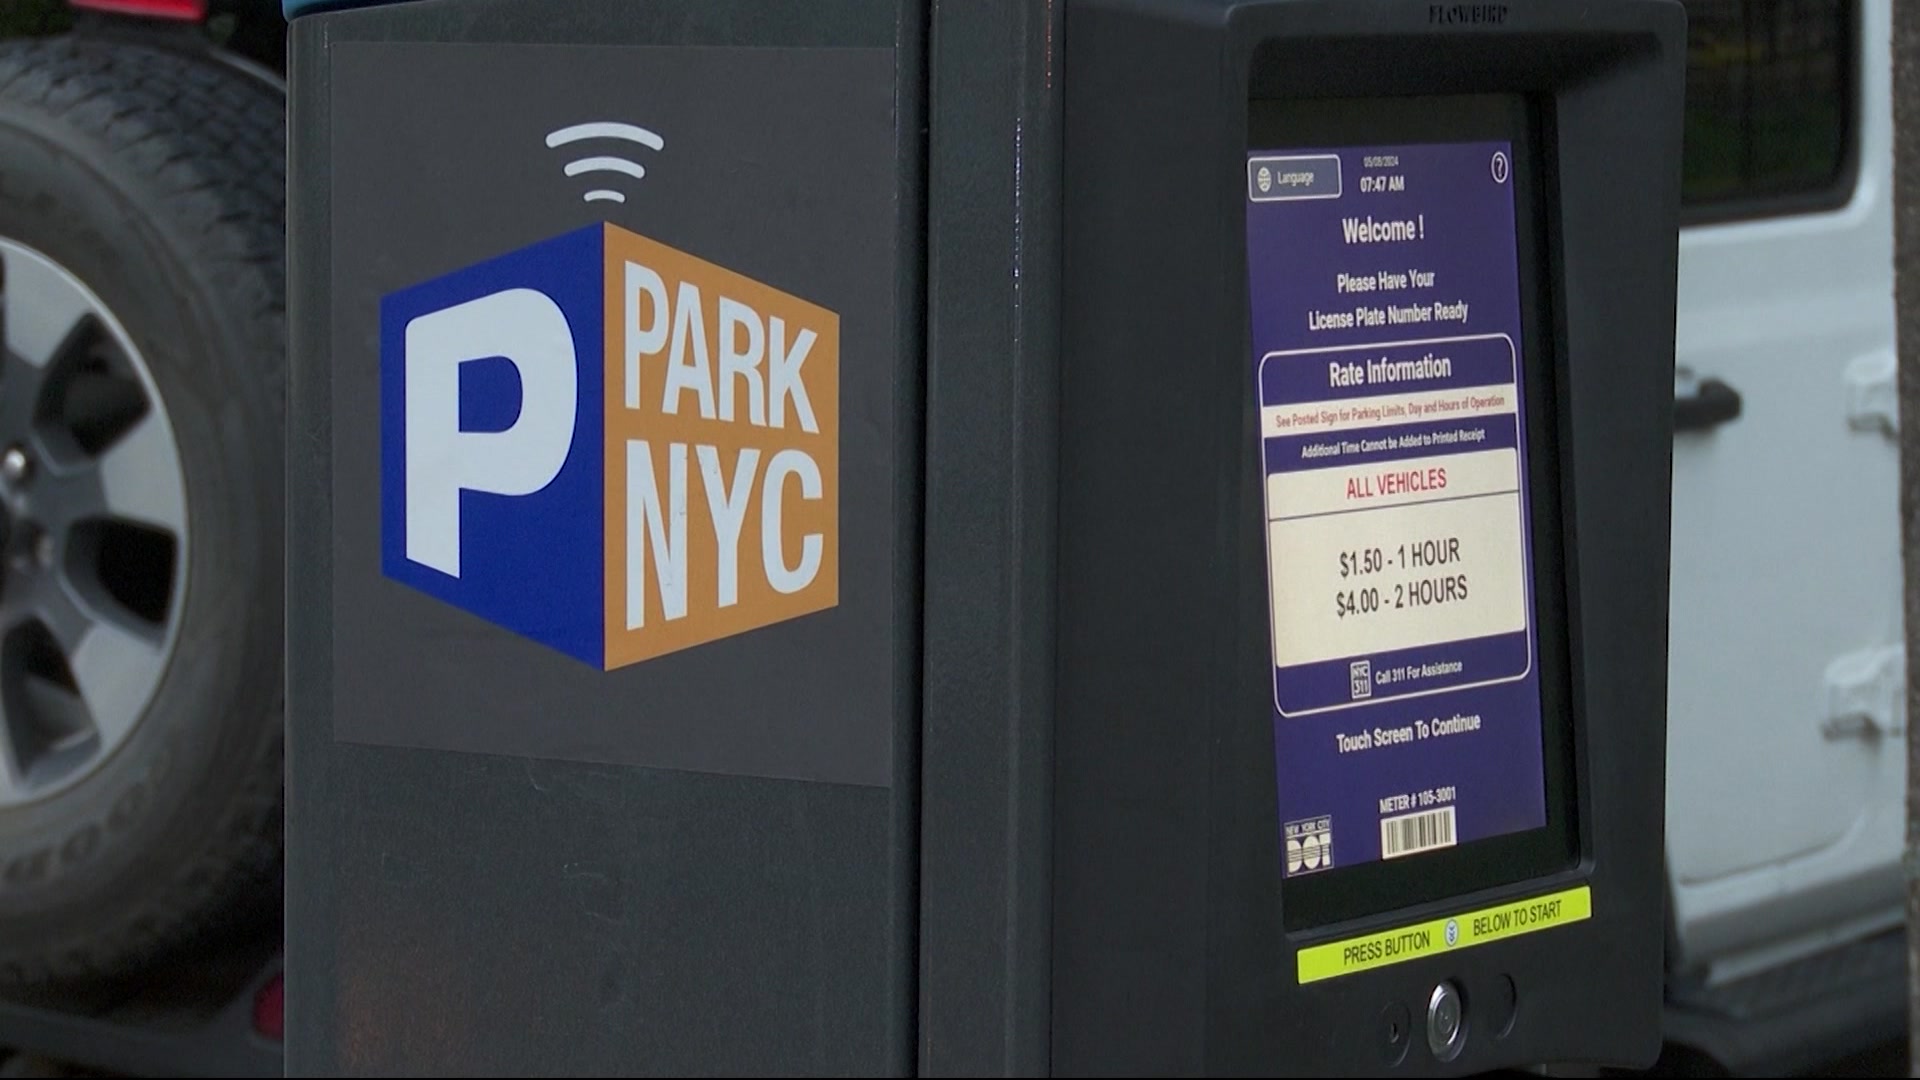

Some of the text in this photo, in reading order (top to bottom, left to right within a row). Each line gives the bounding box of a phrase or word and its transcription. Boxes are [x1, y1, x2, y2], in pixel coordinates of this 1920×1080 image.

[1429, 4, 1508, 24] FLOWBIRD
[1277, 170, 1314, 185] Language
[1360, 175, 1405, 193] 07:47 AM
[1342, 215, 1416, 244] Welcome
[1337, 269, 1435, 293] Please Have Your
[1308, 300, 1468, 331] License Plate Number Ready
[625, 260, 820, 434] PARK
[1329, 353, 1452, 388] Rate Information
[1275, 394, 1505, 429] See Posted Sign for Parking Limits, Day and Hours of Operation
[405, 288, 577, 579] P
[1301, 428, 1485, 459] Additional Time Cannot be Added to Printed Receipt
[1346, 467, 1447, 500] ALL VEHICLES
[626, 438, 823, 631] NYC
[1340, 547, 1382, 579] $1.50
[1398, 544, 1406, 569] 1
[1411, 537, 1461, 568] HOUR
[1336, 587, 1379, 619] $4.00
[1394, 584, 1404, 609] 2
[1408, 574, 1468, 607] HOURS
[1353, 665, 1368, 677] NYC
[1354, 679, 1368, 694] 311
[1375, 661, 1463, 685] Call 311 For Assistance
[1336, 713, 1481, 753] Touch Screen To Continue
[1379, 786, 1456, 814] METER # 105-3001
[1286, 819, 1331, 835] NEW YORK CITY
[1287, 833, 1331, 873] DOT
[1343, 900, 1562, 966] PRESS BUTTON BELOW TO START
